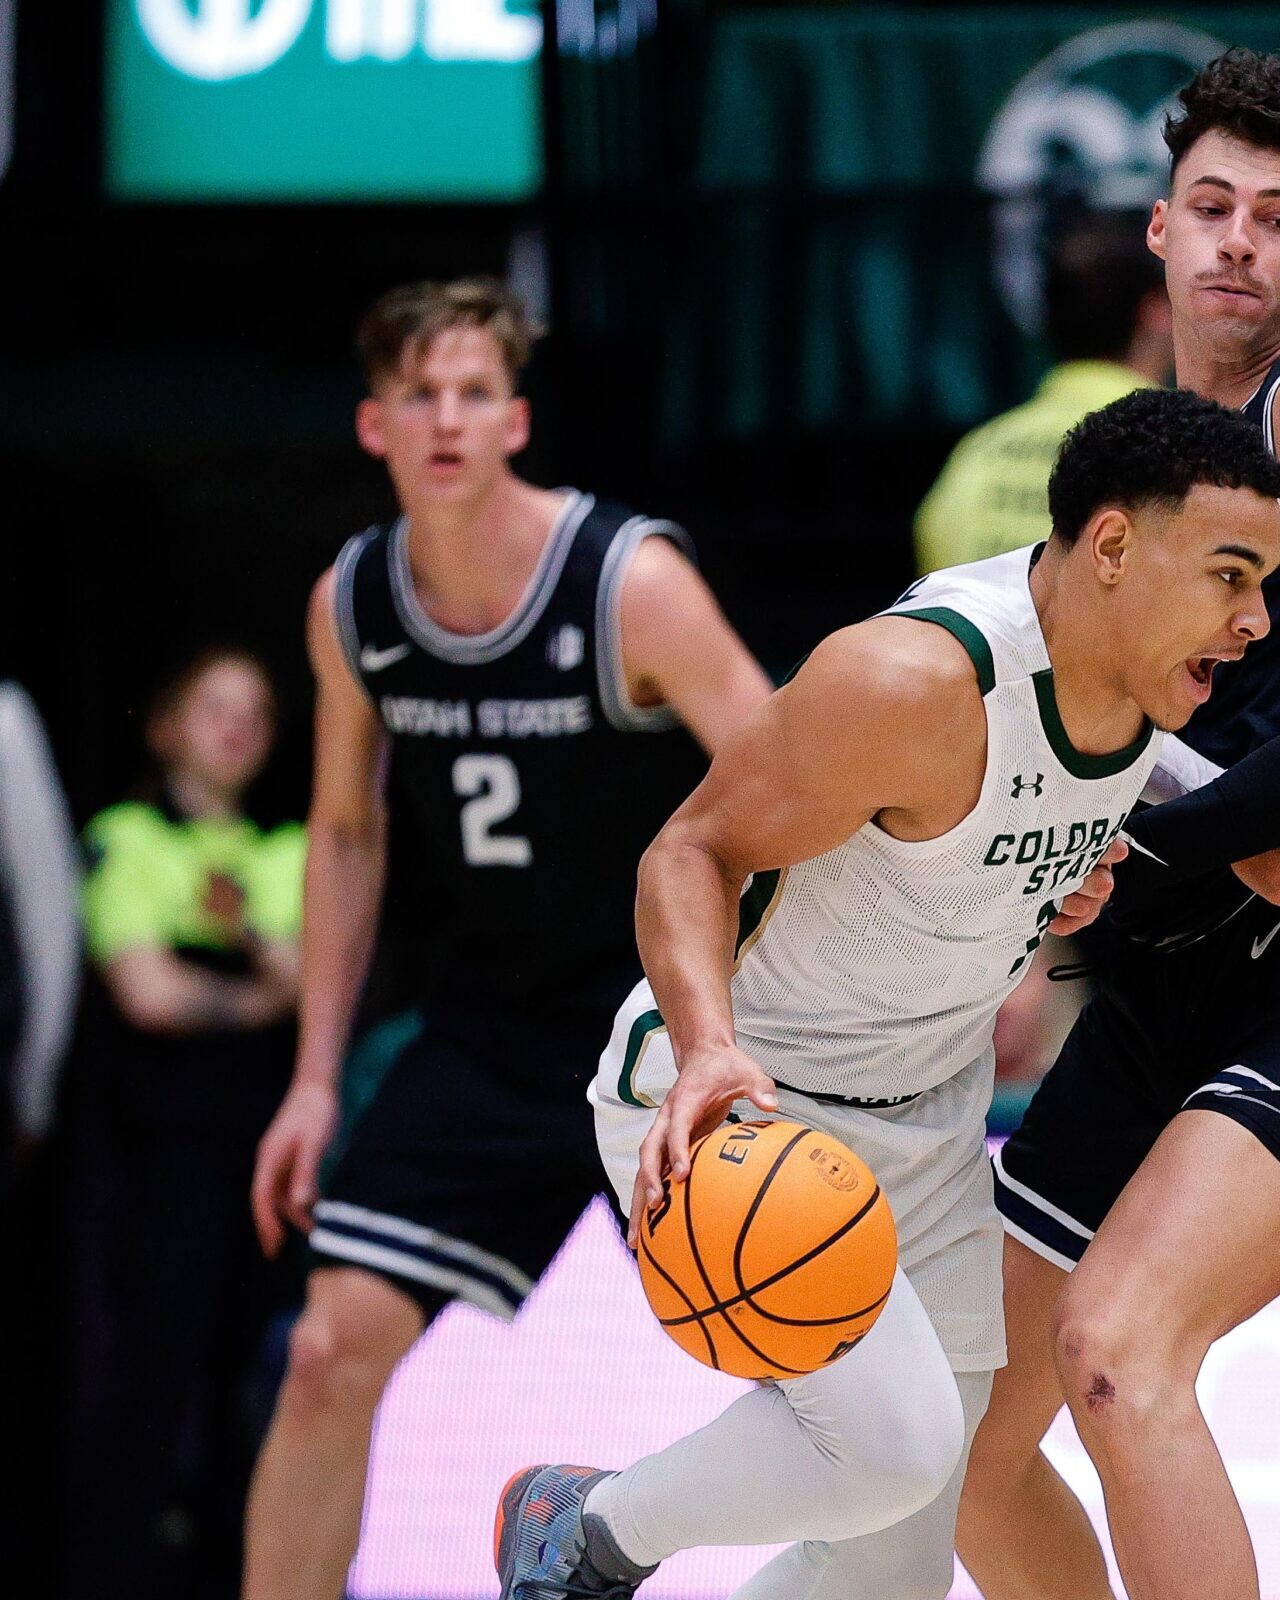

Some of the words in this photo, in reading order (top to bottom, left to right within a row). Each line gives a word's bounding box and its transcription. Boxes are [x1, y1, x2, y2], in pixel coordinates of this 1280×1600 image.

[381, 695, 471, 737] UTAH
[476, 695, 594, 737] STATE
[452, 754, 533, 867] 2
